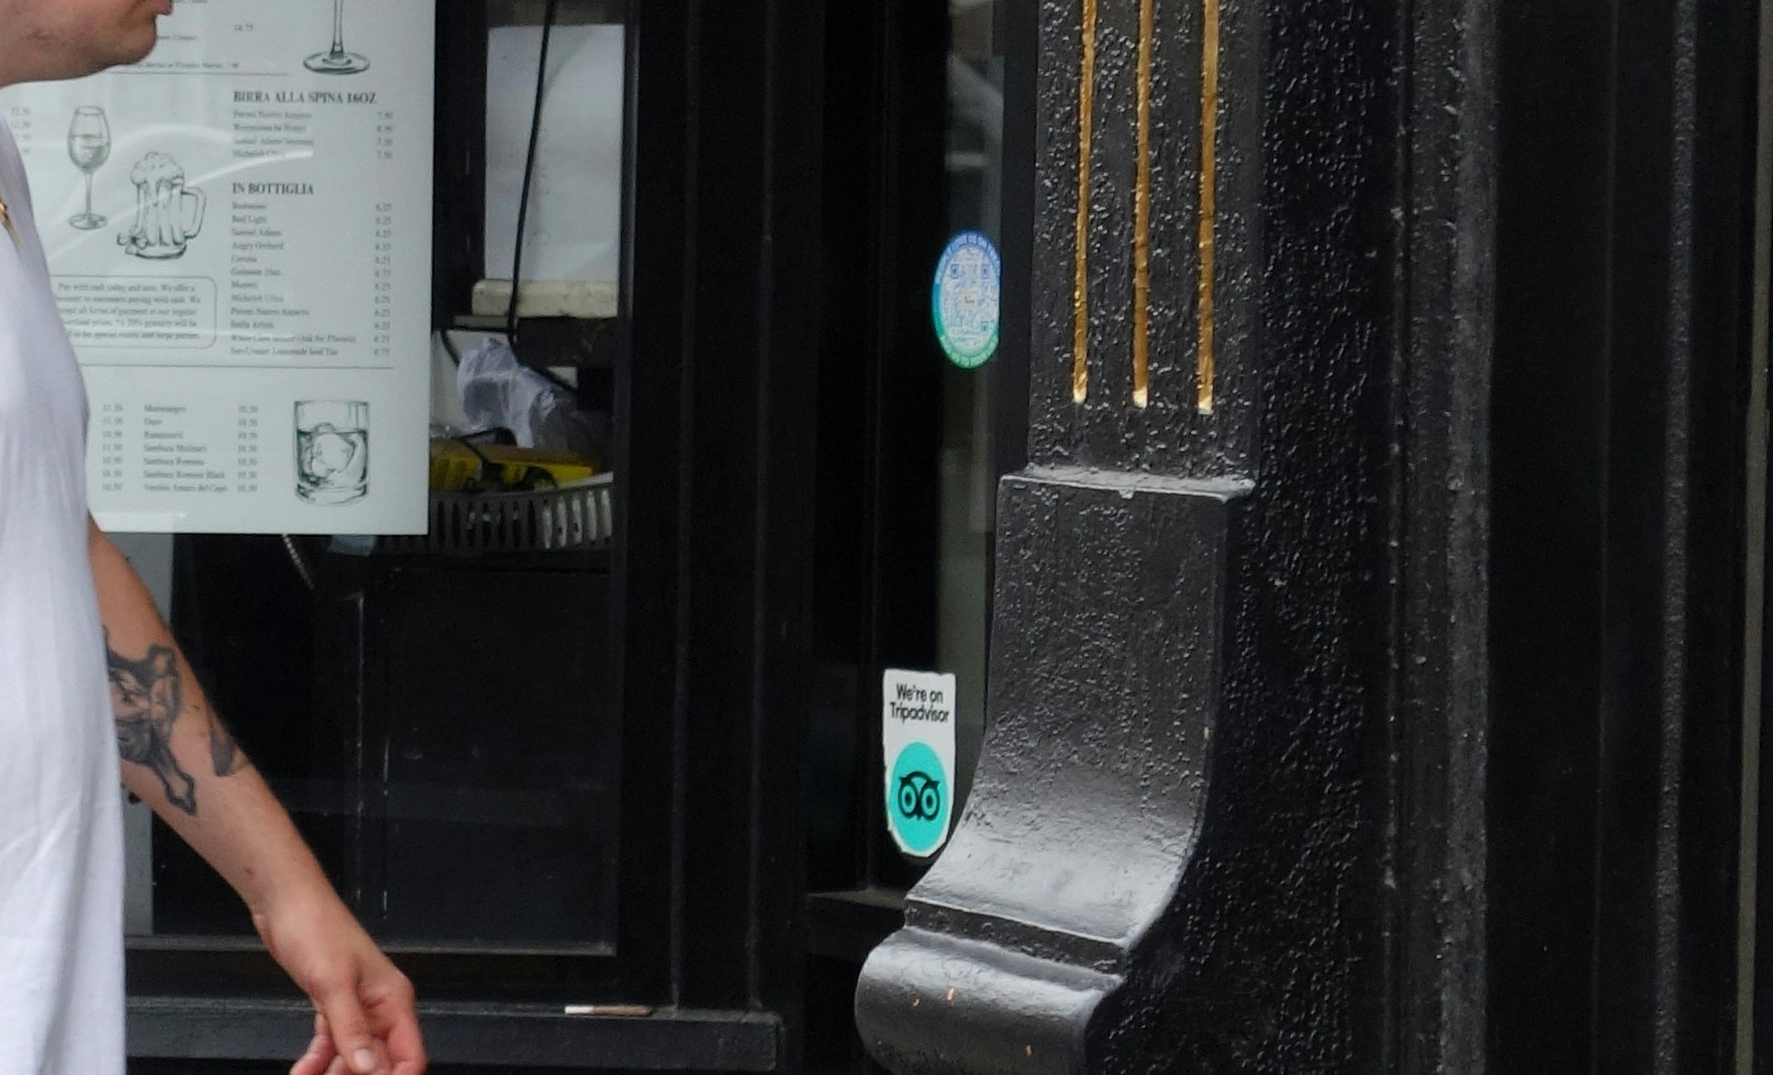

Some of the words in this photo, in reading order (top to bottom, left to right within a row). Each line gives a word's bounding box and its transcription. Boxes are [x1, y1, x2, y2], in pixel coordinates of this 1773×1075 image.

[233, 91, 270, 103] BIRRA
[276, 91, 305, 103] ALLA
[308, 92, 344, 104] SPINA
[232, 182, 246, 194] IN
[248, 182, 315, 195] BOTTIGLIA
[896, 683, 927, 702] We're
[930, 690, 944, 704] on
[890, 701, 950, 724] Tripadvisor
